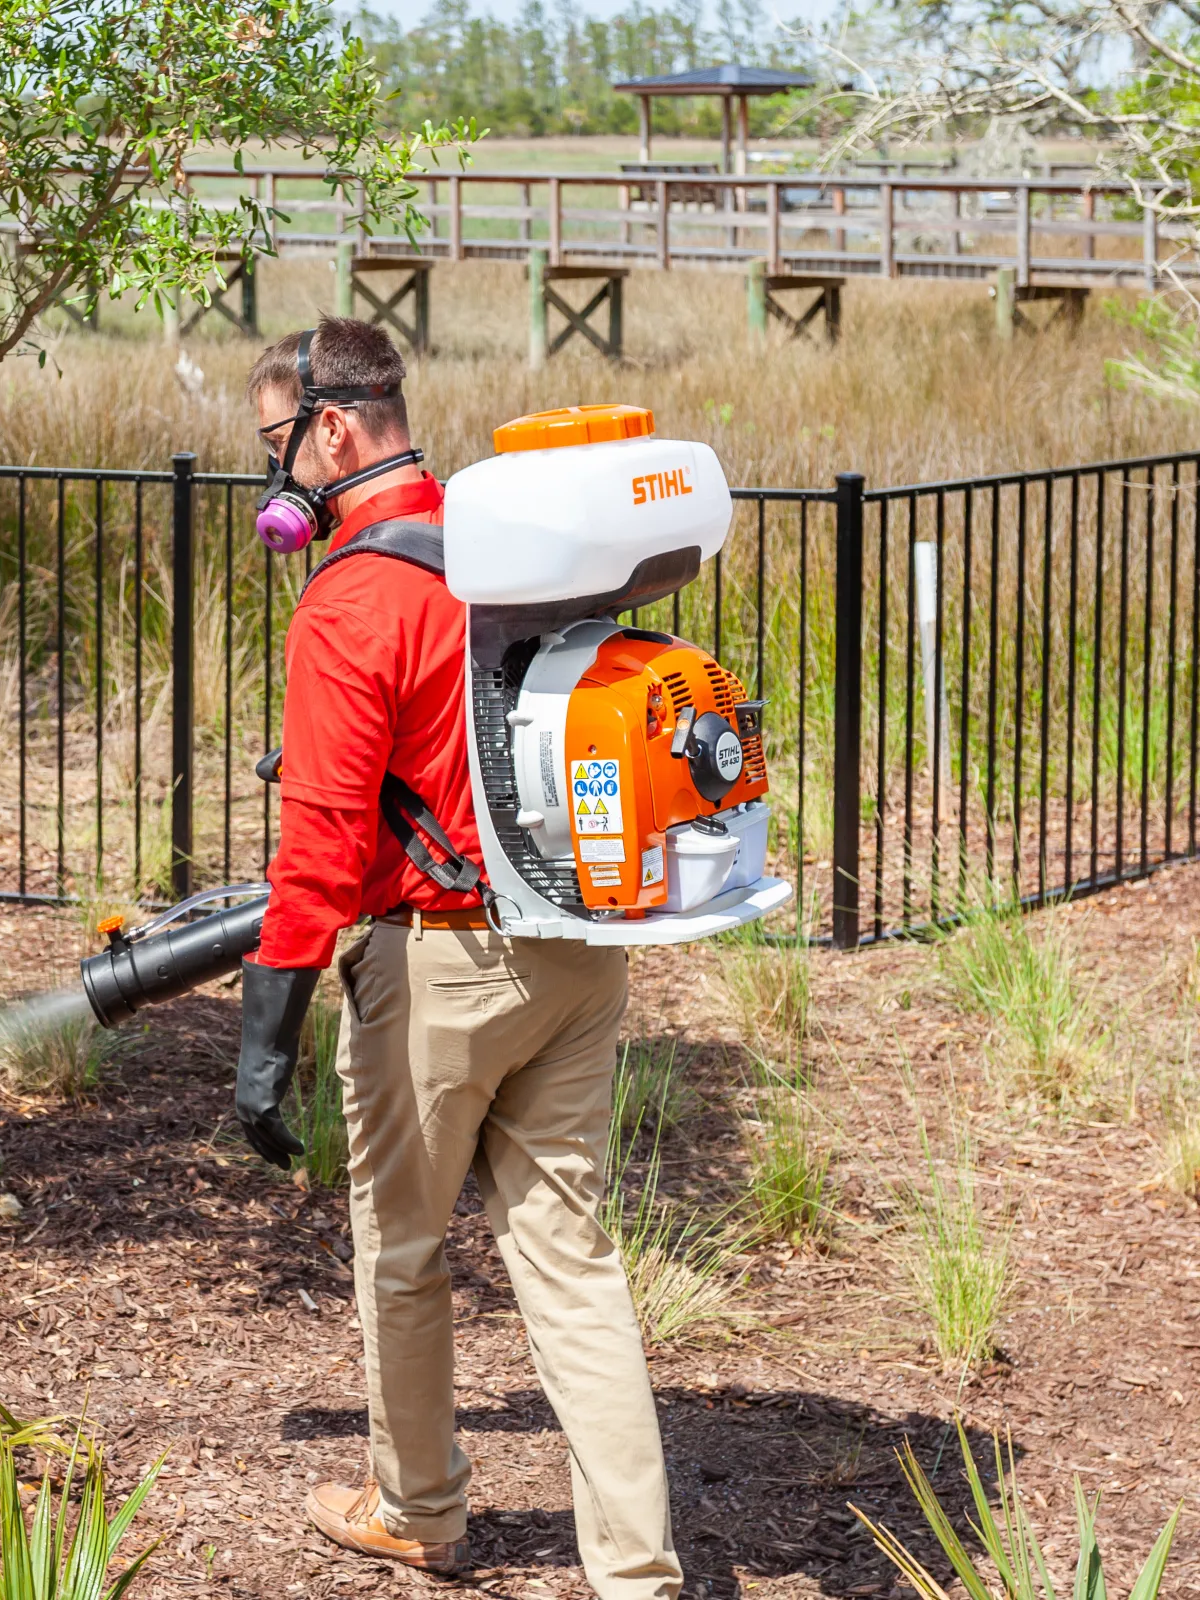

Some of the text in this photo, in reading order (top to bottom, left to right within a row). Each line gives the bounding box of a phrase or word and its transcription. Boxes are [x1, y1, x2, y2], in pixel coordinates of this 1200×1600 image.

[632, 468, 693, 505] STIHL
[719, 745, 740, 760] STIHL
[721, 756, 739, 768] SR 430
